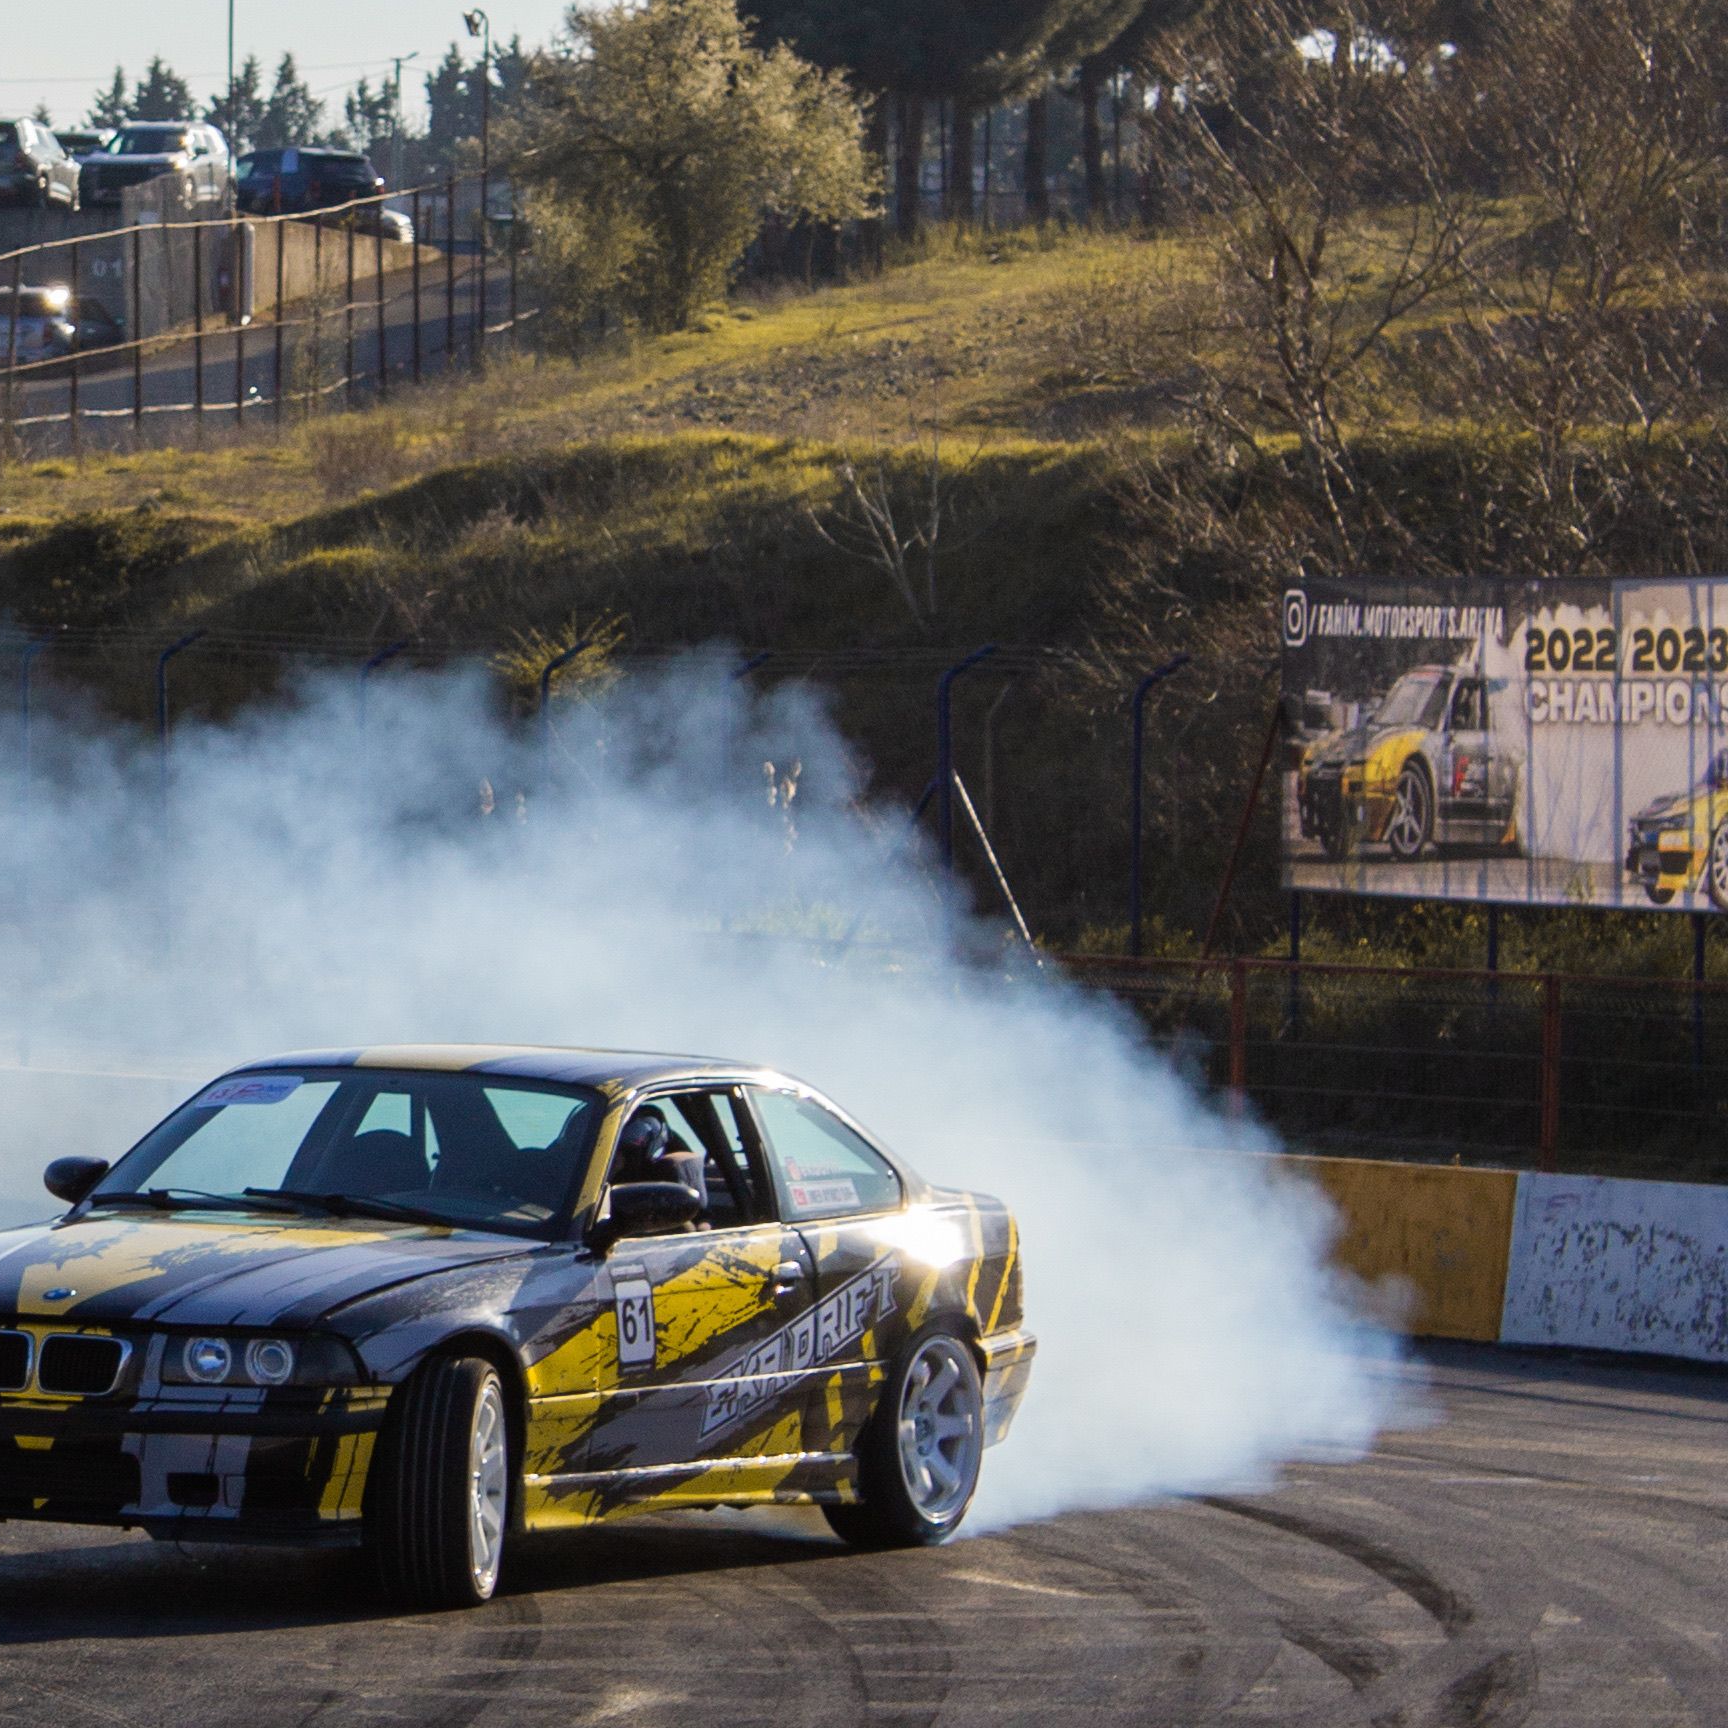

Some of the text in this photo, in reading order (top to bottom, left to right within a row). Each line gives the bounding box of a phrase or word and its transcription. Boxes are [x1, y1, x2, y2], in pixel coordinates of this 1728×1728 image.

[1525, 628, 1728, 671] 2022 2023
[622, 1296, 651, 1345] 61
[786, 1248, 902, 1380] DRIFT
